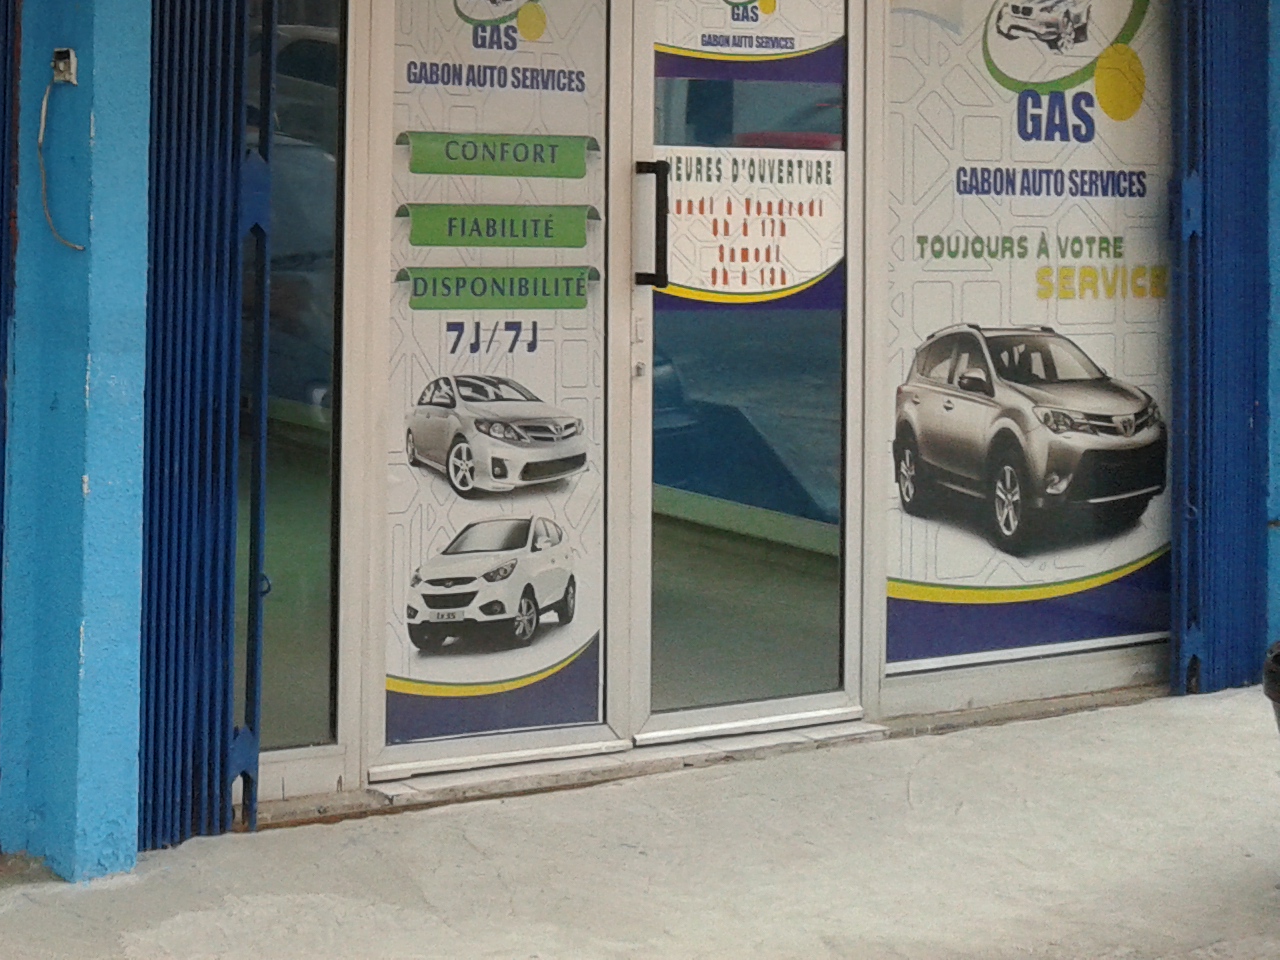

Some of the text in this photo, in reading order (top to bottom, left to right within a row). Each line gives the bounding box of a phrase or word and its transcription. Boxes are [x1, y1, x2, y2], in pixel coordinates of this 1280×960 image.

[731, 5, 759, 23] GAS
[472, 24, 518, 51] GAS
[701, 33, 795, 50] GABON AUTO SERVICES
[407, 61, 586, 92] GABON AUTO SERVICES
[1017, 89, 1095, 143] GAS
[445, 140, 559, 164] CONFORT
[732, 157, 832, 185] D'OUVERTURE
[956, 166, 1147, 198] GABON AUTO SERVICES
[446, 213, 554, 239] FIABILITÉ
[916, 231, 1124, 260] TOUJOURS À VOTRE
[413, 272, 586, 299] DISPONIBILITÉ
[1036, 265, 1167, 300] SERVICE
